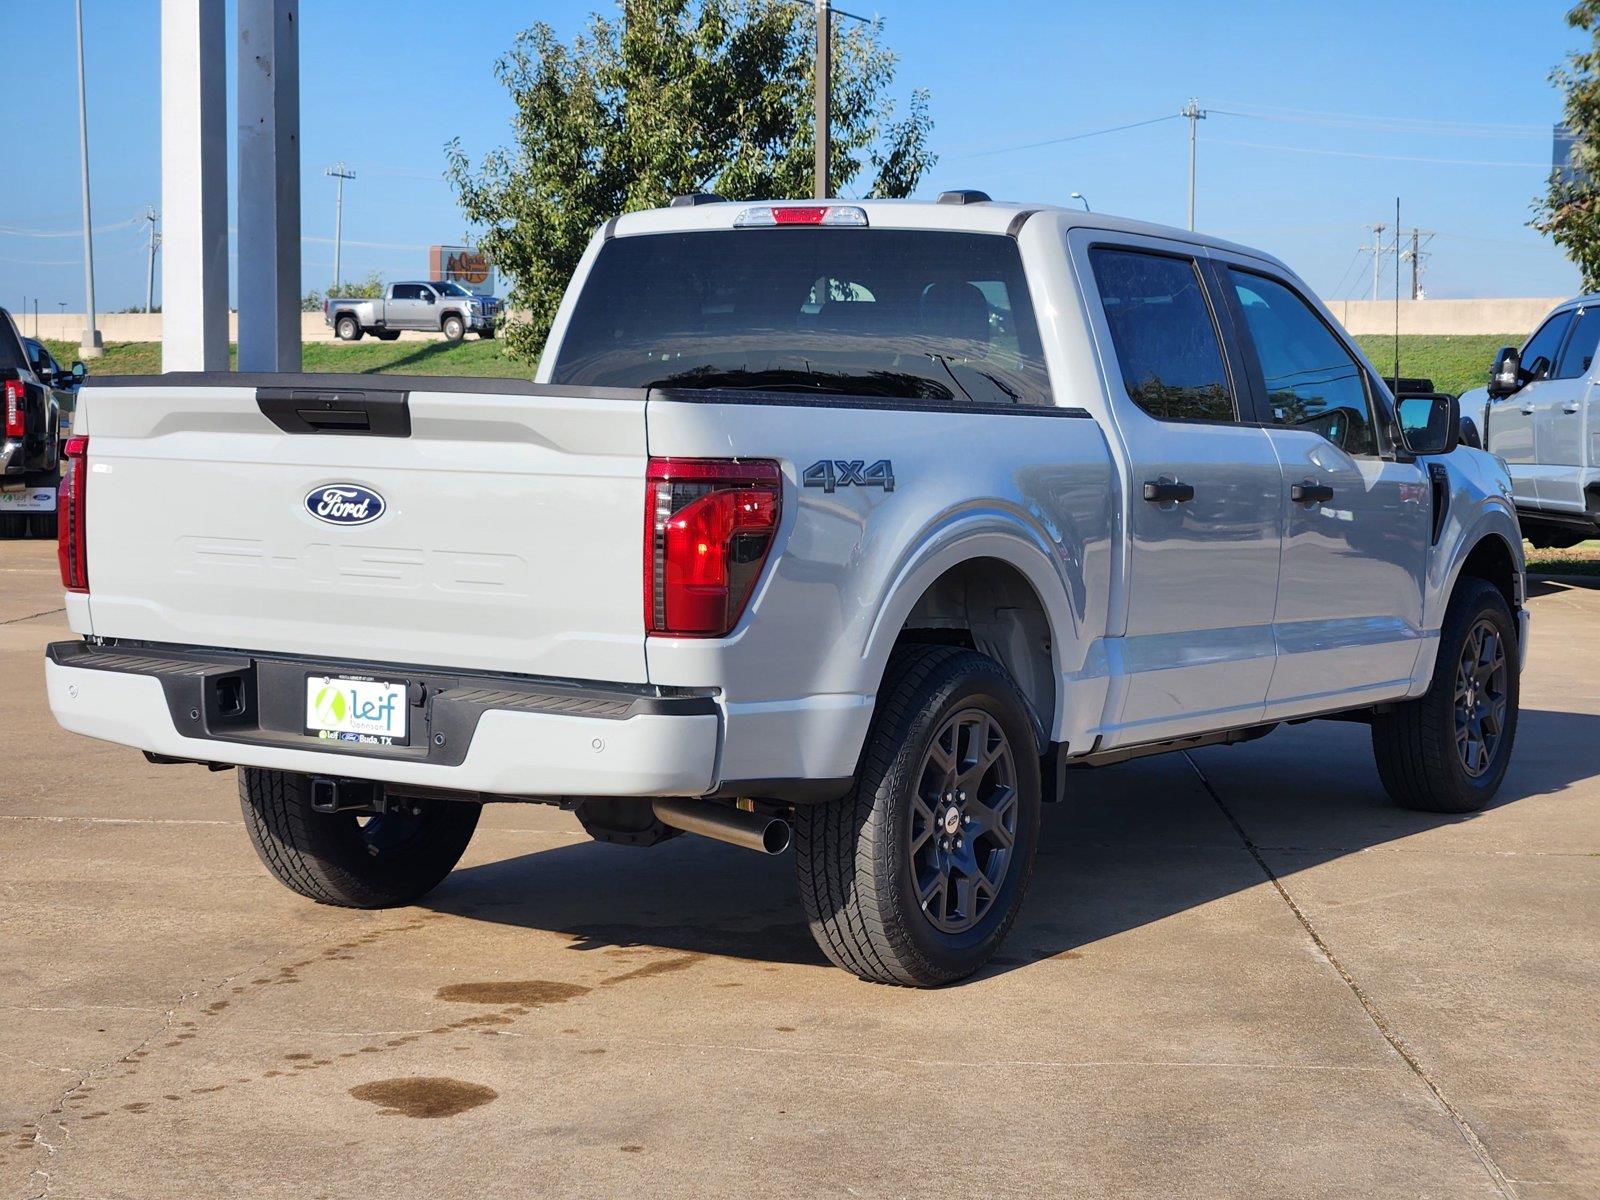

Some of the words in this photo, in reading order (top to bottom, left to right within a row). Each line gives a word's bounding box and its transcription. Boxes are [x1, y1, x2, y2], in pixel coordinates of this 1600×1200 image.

[317, 489, 370, 518] Ford
[350, 689, 398, 731] leif
[380, 736, 392, 745] TX
